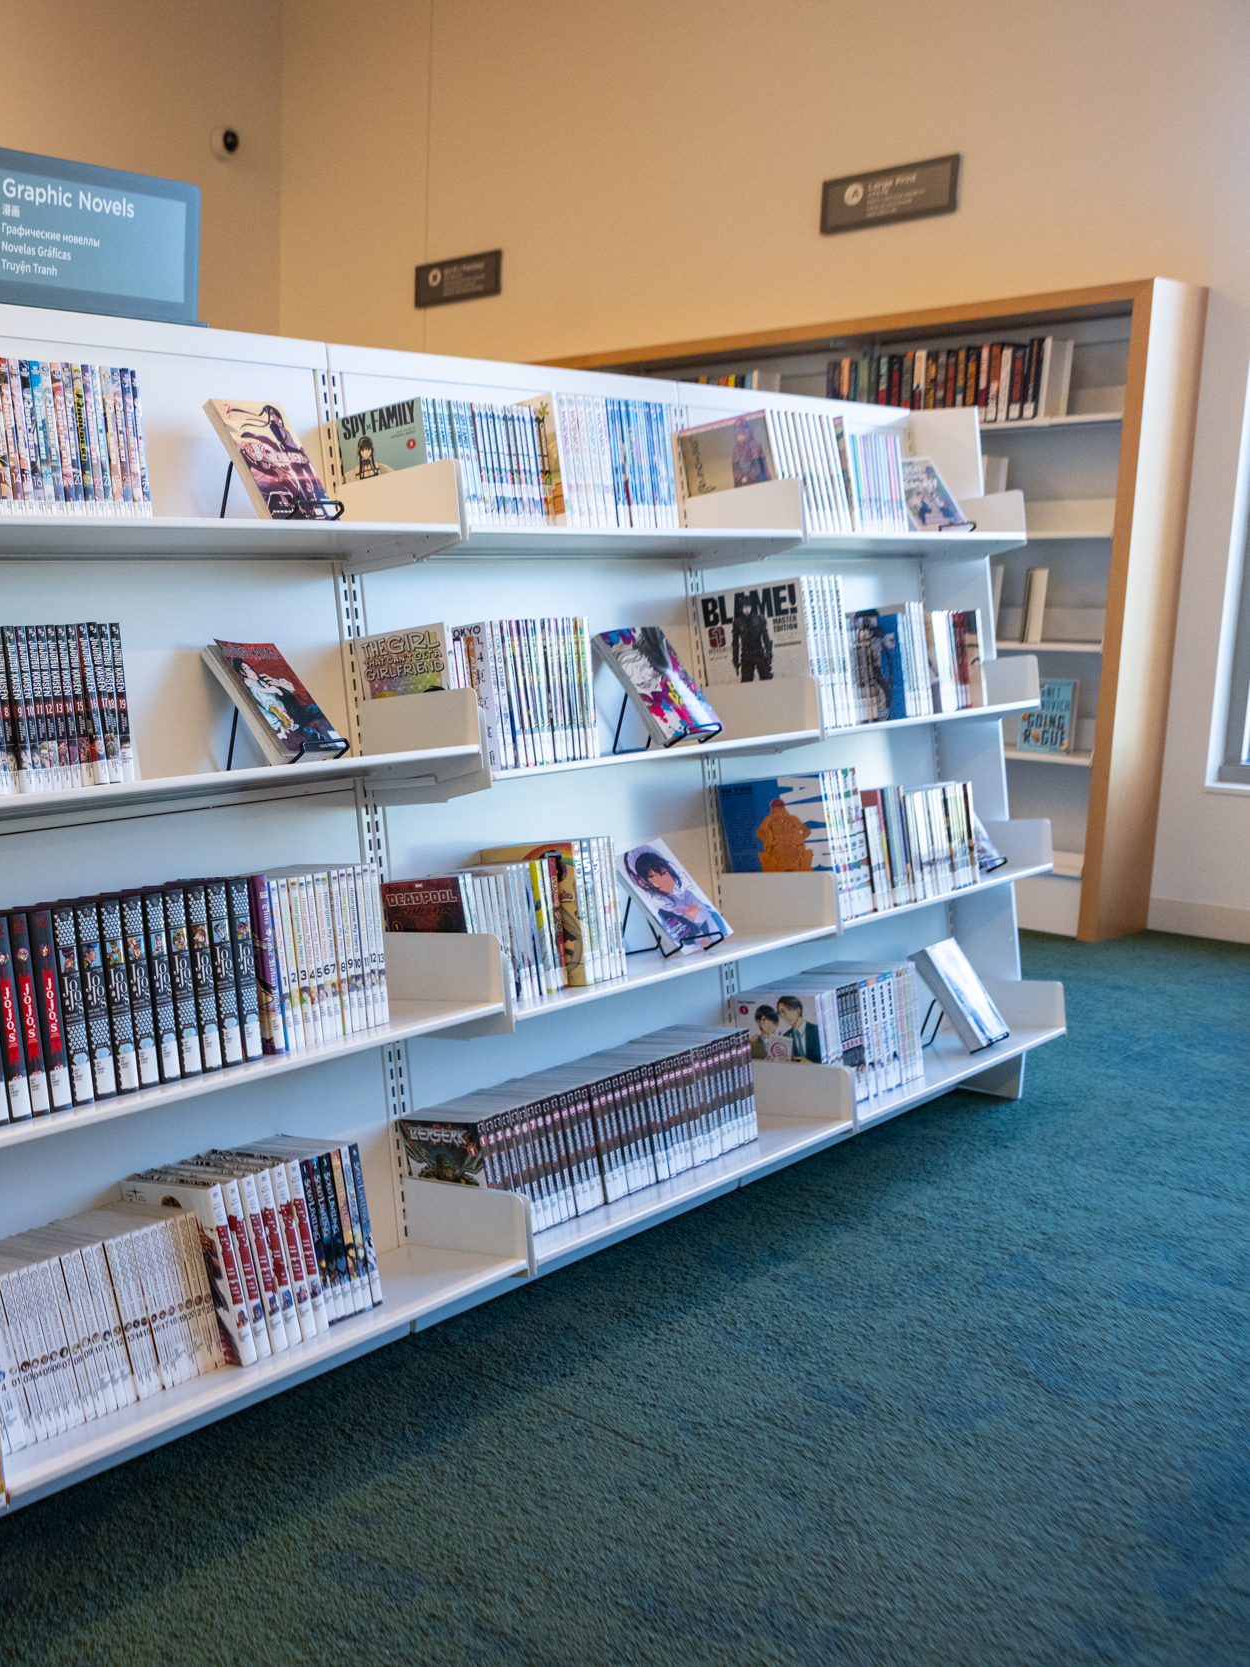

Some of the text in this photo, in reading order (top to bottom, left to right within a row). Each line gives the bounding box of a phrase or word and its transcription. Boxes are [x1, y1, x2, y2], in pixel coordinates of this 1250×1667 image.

[2, 177, 135, 219] Graphic Novels
[2, 203, 20, 218] 漫画
[1, 222, 100, 247] Графические новеллы
[1, 241, 71, 261] Novelas Gráficas
[1, 259, 58, 277] Truyện Tranh
[342, 399, 418, 442] SPY FAMILY
[701, 583, 798, 628] BLAME!
[772, 615, 797, 625] MASTER
[773, 622, 798, 632] EDITION
[361, 630, 441, 659] THE GIRL
[363, 649, 443, 669] THAT CAN'T GET A
[364, 659, 445, 682] GIRLFRIEND
[1025, 712, 1065, 731] GOING
[385, 889, 458, 908] DEADPOOL
[409, 1125, 470, 1147] BERSERK
